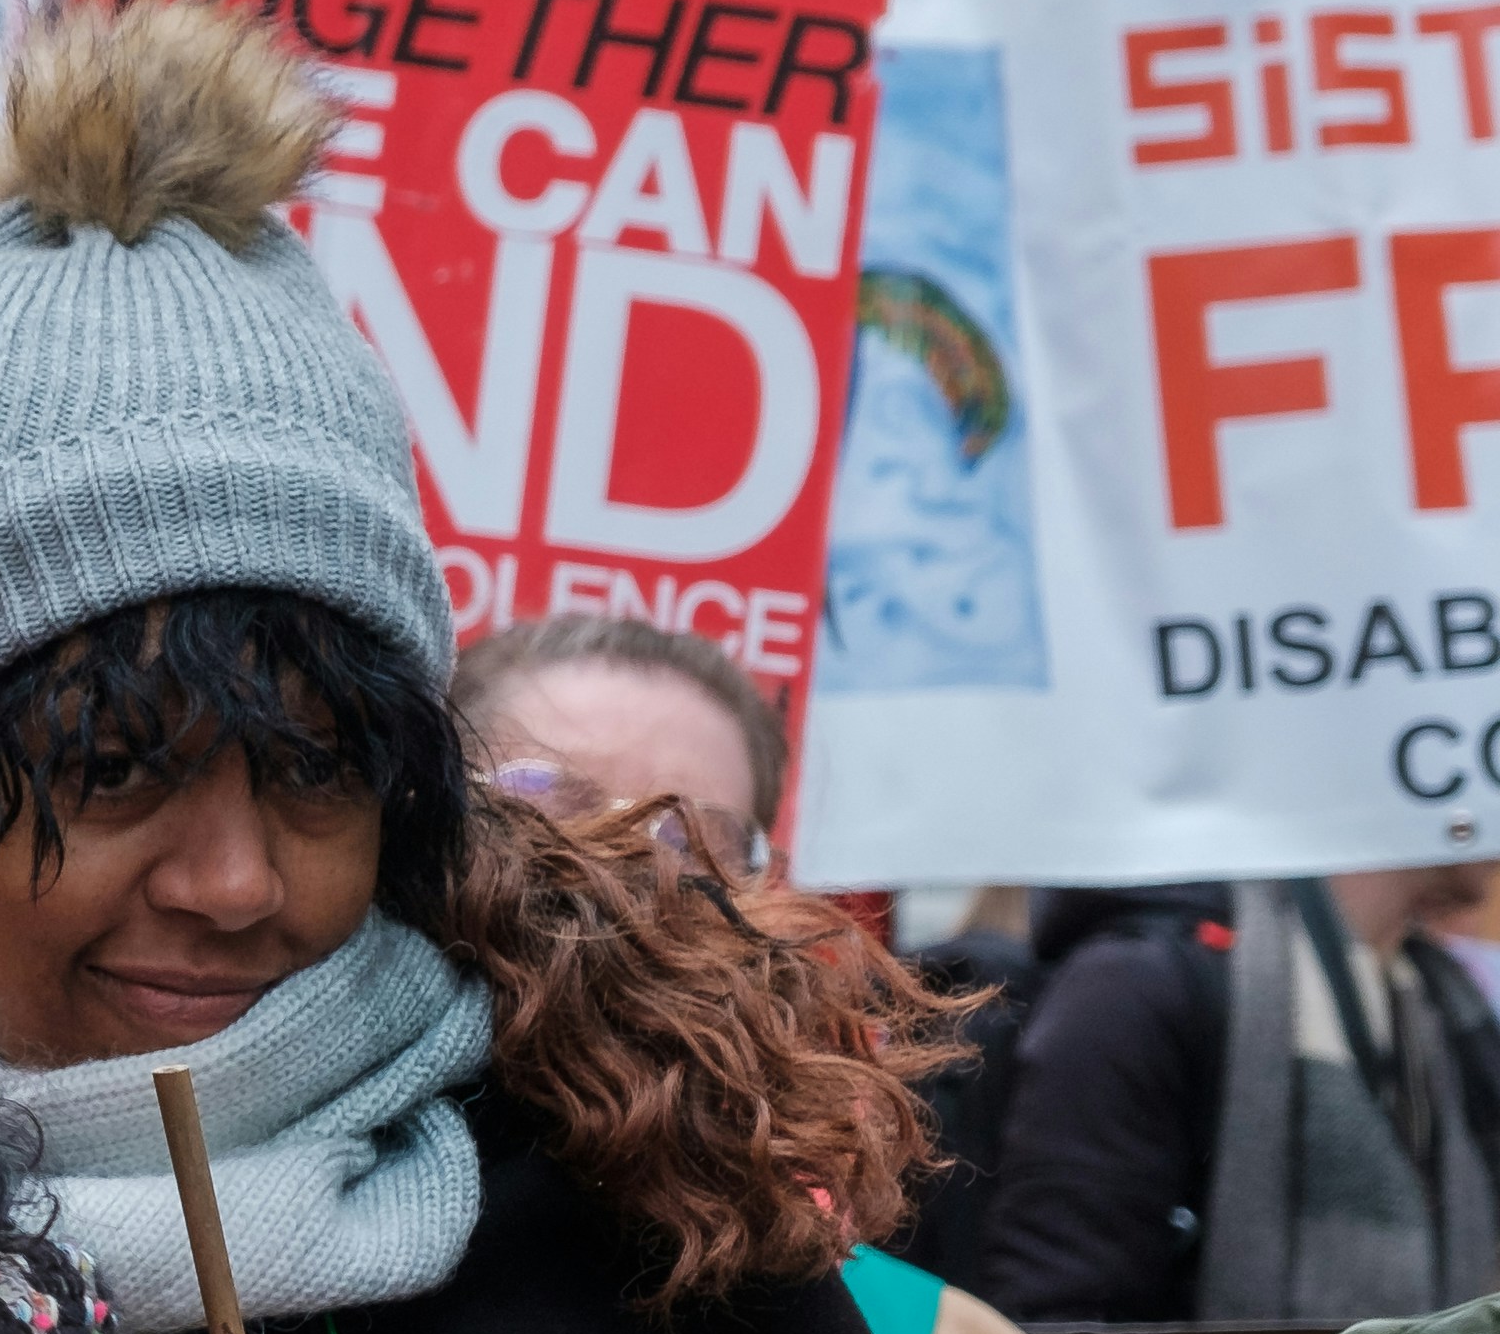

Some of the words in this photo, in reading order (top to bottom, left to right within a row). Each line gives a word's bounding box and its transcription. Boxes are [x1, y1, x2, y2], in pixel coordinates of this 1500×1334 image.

[455, 87, 856, 281] CAN
[1152, 591, 1500, 704] DISAB
[1390, 716, 1500, 802] C
